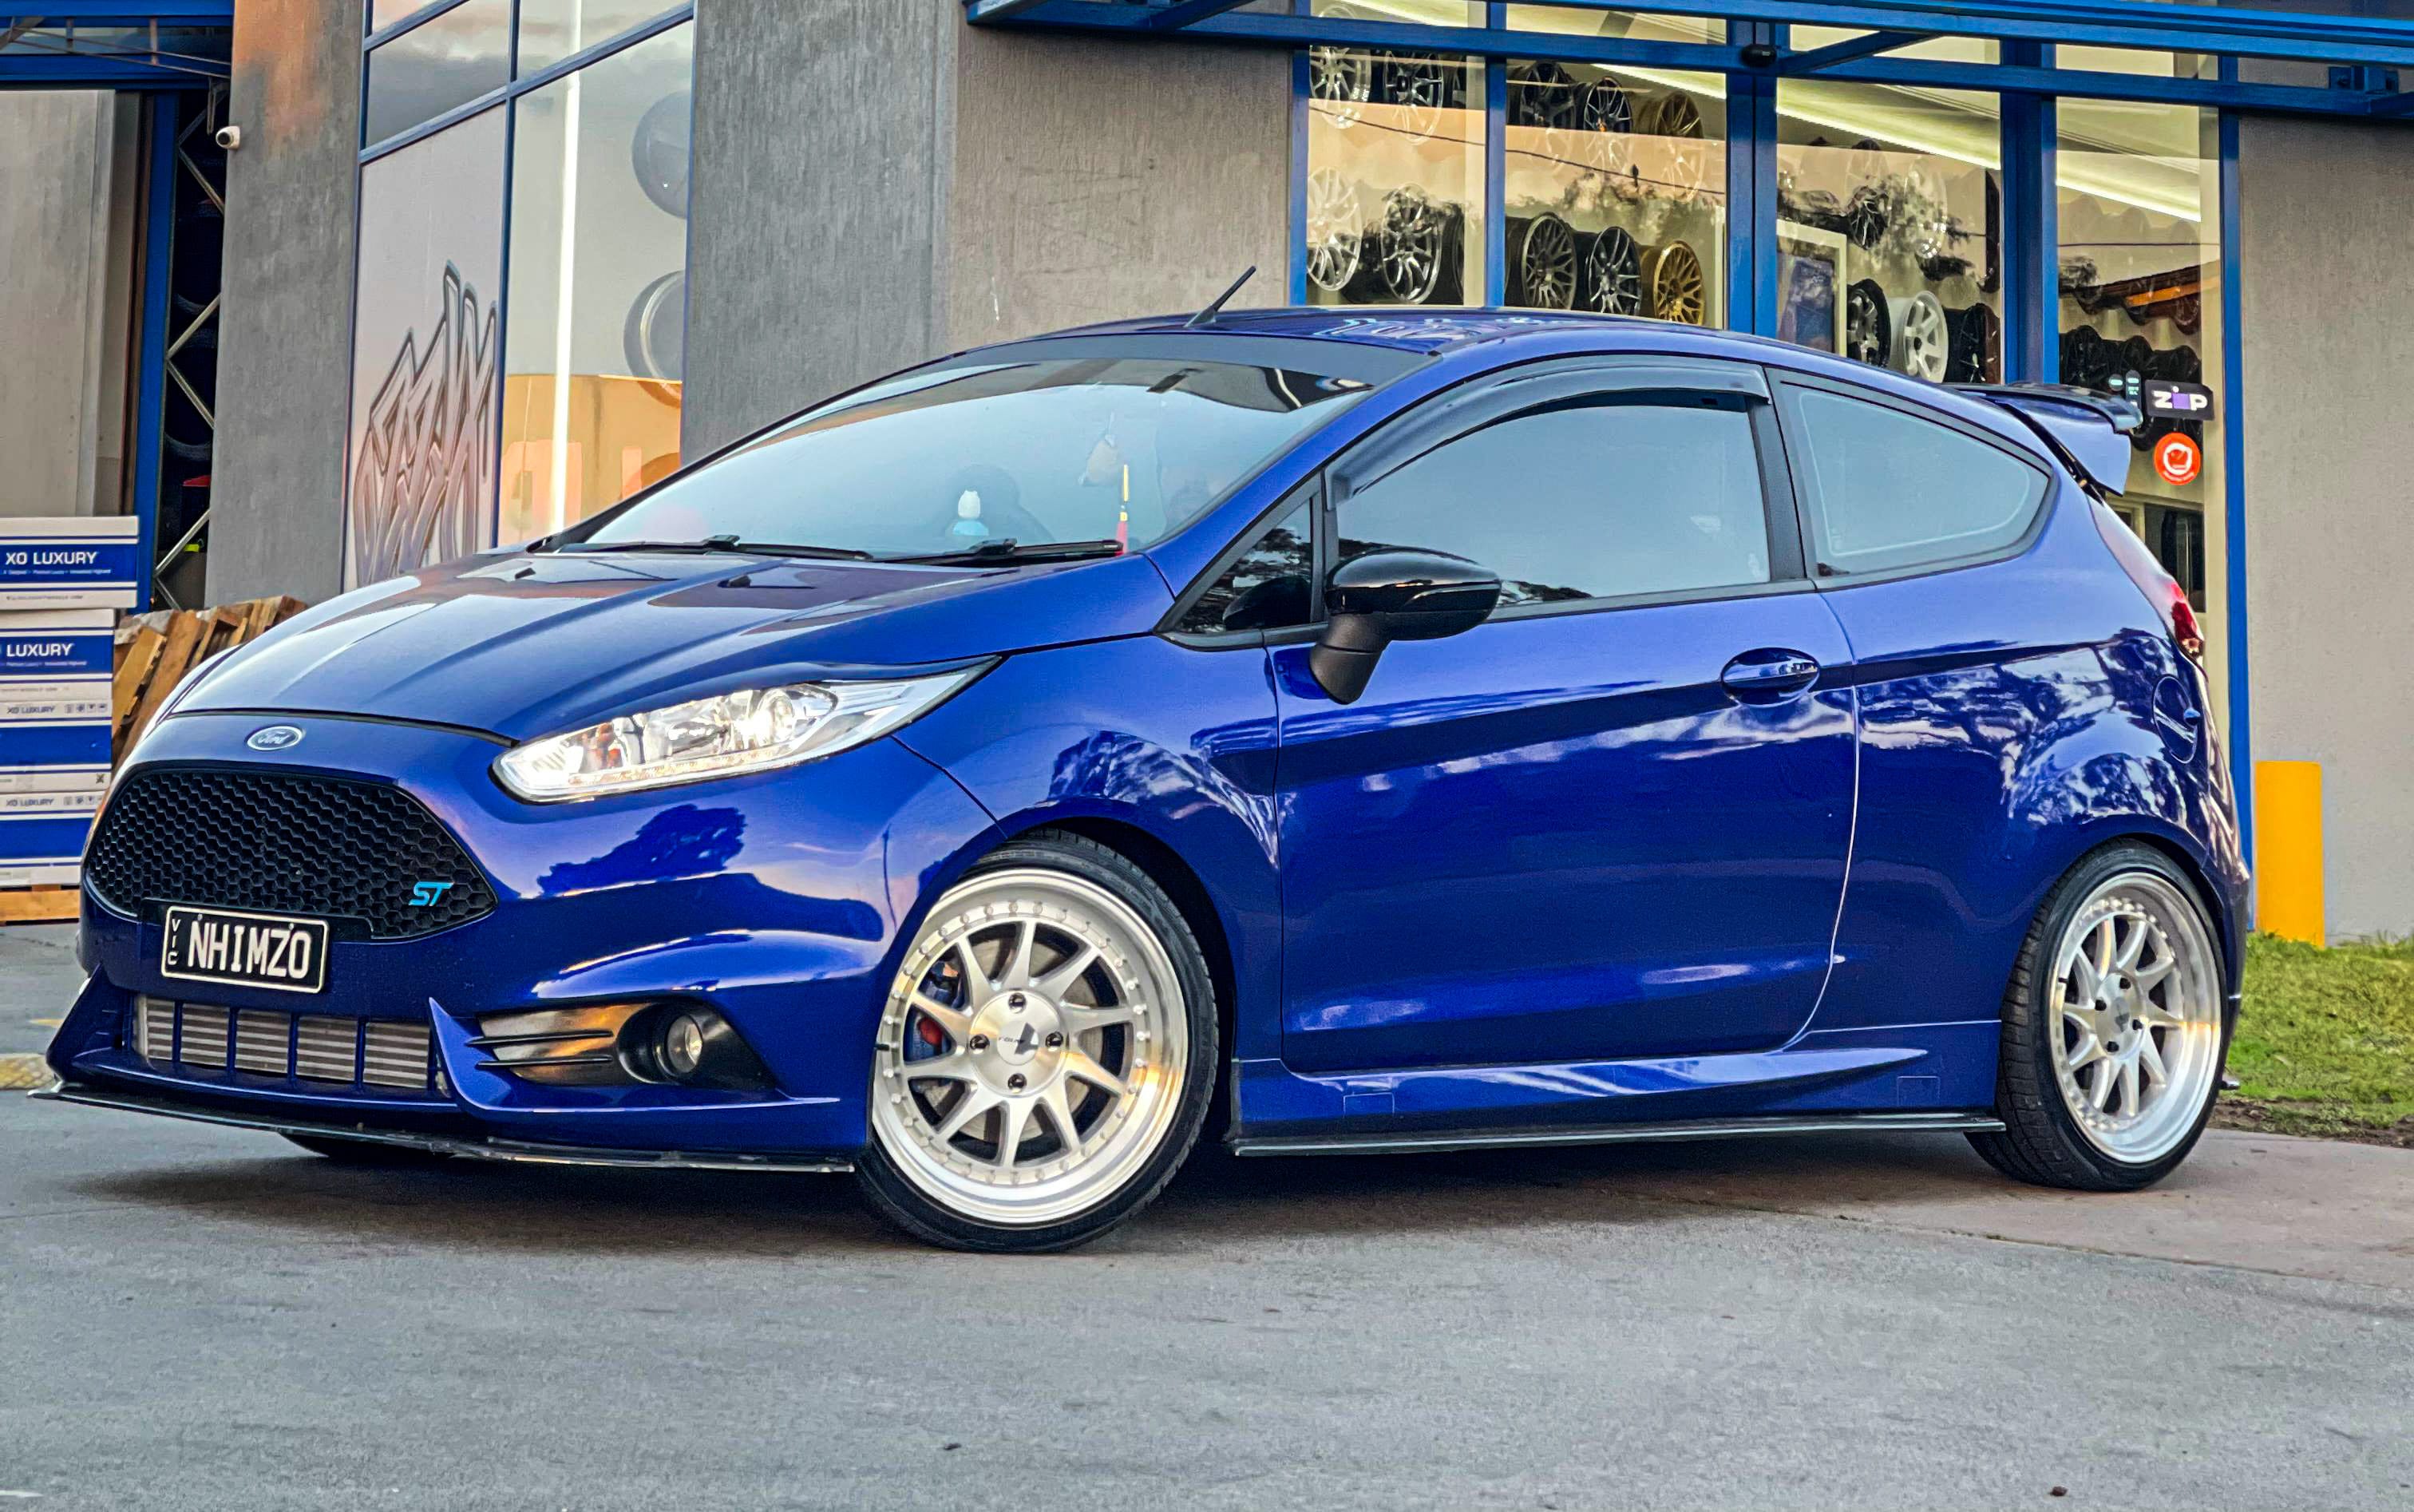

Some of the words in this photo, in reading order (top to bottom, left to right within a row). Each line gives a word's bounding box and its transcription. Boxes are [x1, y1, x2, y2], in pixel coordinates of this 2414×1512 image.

[6, 552, 28, 565] XO
[33, 551, 98, 564] LUXURY
[6, 643, 75, 657] LUXURY
[408, 881, 455, 907] ST
